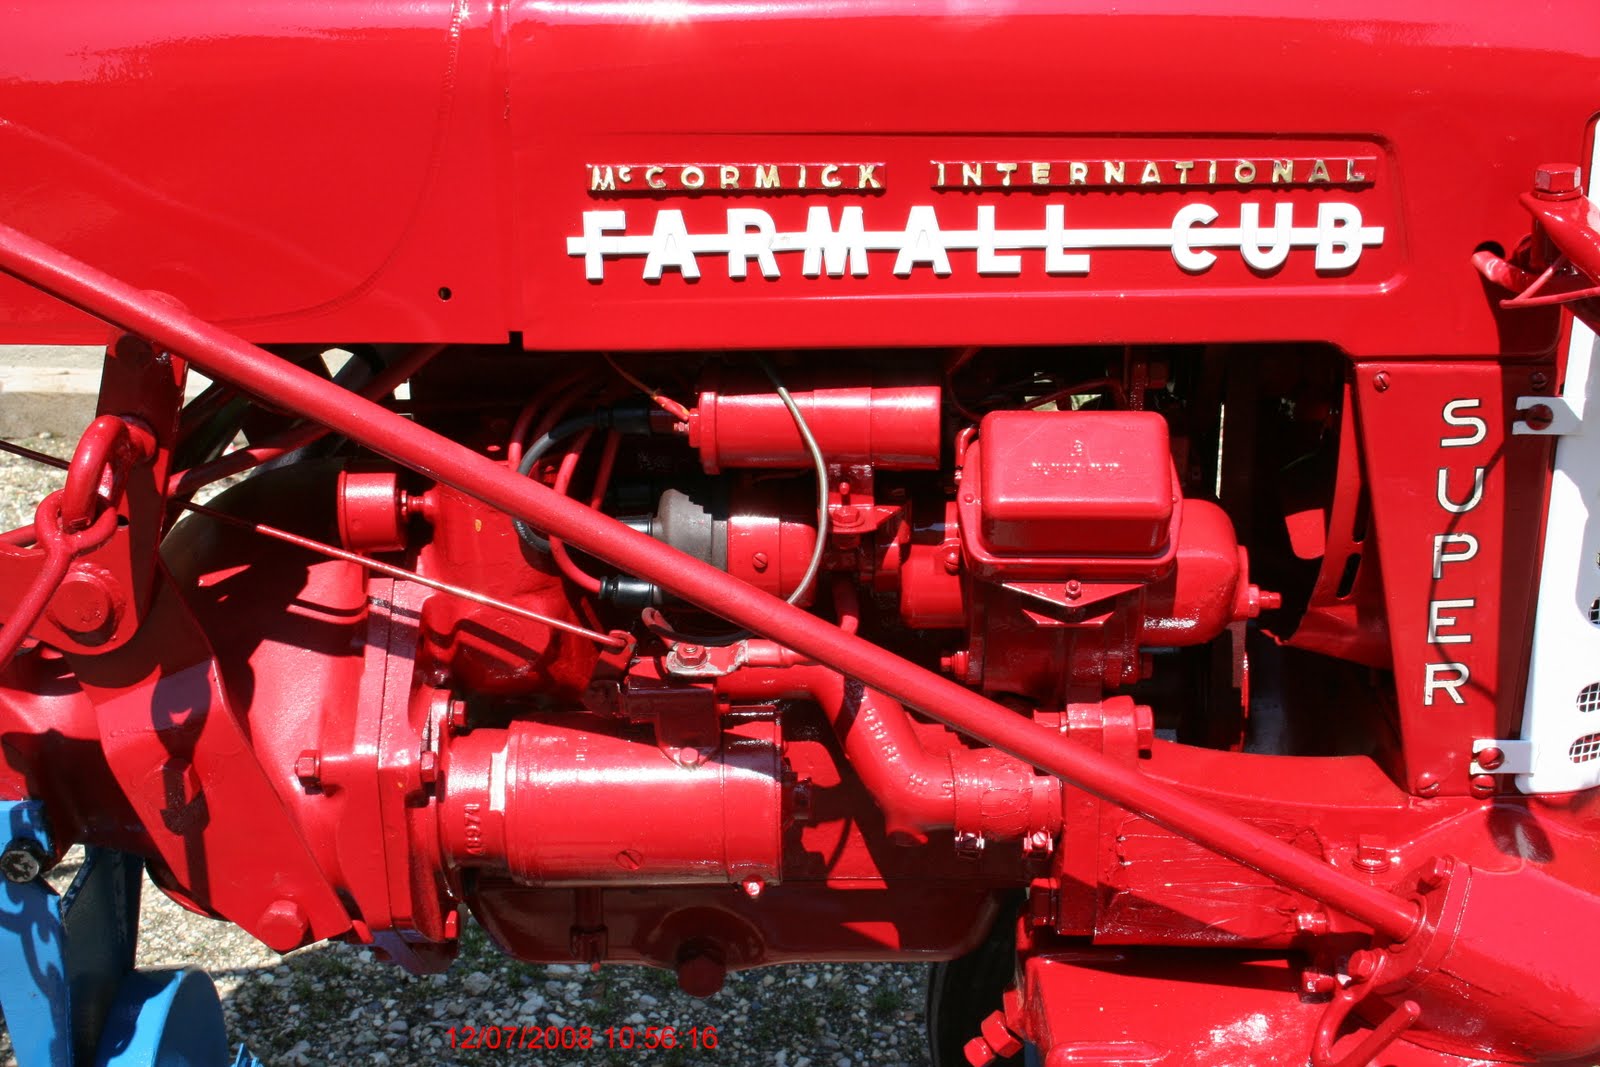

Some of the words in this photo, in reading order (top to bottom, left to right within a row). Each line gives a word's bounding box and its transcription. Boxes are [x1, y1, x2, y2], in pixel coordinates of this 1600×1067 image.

[936, 159, 1366, 187] INTERNATIONAL
[582, 204, 1091, 280] FARMALL
[1170, 202, 1363, 273] CUB
[1423, 398, 1488, 706] SUPER
